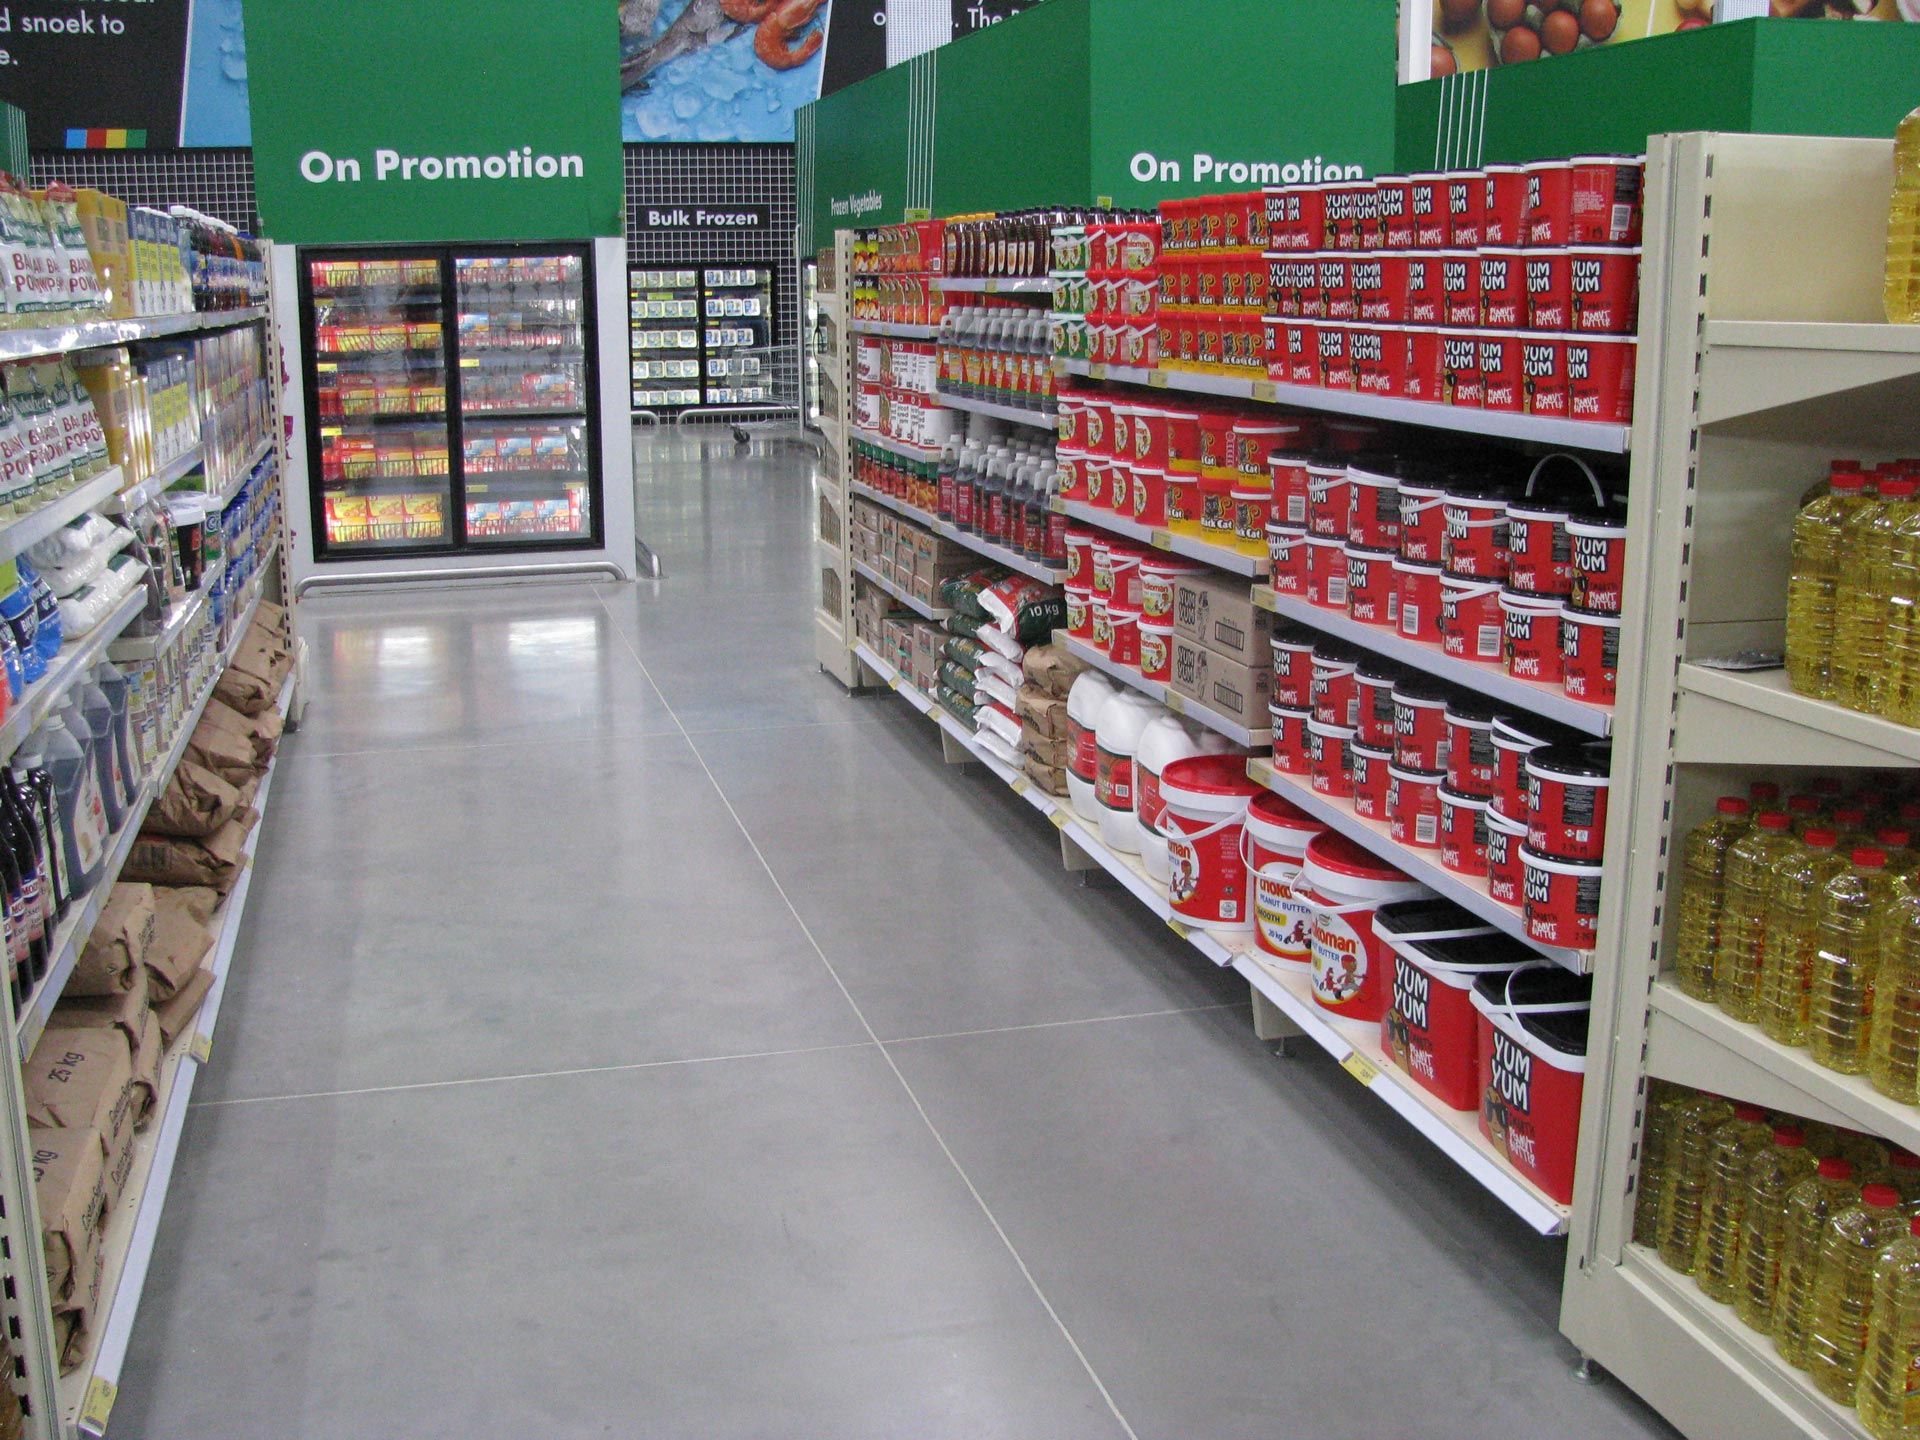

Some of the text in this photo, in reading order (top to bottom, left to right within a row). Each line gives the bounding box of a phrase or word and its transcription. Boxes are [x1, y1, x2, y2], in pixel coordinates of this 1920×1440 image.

[22, 9, 95, 34] snoek
[101, 14, 125, 35] to
[300, 147, 585, 184] On Promotion
[1130, 152, 1363, 183] On Promotion
[1378, 189, 1403, 202] YUM
[1413, 187, 1431, 200] UM
[1450, 185, 1466, 199] UM
[831, 190, 882, 218] Frozen Vegetables
[1326, 194, 1351, 207] YUM
[1352, 193, 1377, 206] YUM
[1450, 199, 1466, 213] UM
[1326, 207, 1352, 219] YUM
[1352, 206, 1377, 219] YUM
[1378, 202, 1402, 215] YUM
[1413, 201, 1431, 213] UM
[649, 210, 758, 226] Bulk Frozen
[1291, 264, 1315, 276] YUM
[1320, 264, 1343, 276] YUM
[1410, 263, 1424, 276] UM
[1481, 261, 1506, 275] YUM
[1572, 260, 1600, 276] YUM
[1291, 276, 1315, 288] YUM
[1320, 276, 1343, 288] YUM
[1410, 277, 1424, 290] UM
[1481, 276, 1505, 290] YUM
[1572, 276, 1599, 291] YUM
[1319, 332, 1341, 344] YUM
[1319, 344, 1341, 356] YUM
[1444, 340, 1474, 354] YUM
[1524, 345, 1553, 360] YUM
[1444, 354, 1473, 368] YUM
[1568, 347, 1587, 362] UM
[1524, 360, 1552, 376] YUM
[1568, 364, 1587, 378] UM
[1217, 520, 1232, 529] Cat
[1510, 522, 1527, 537] UM
[1247, 529, 1261, 539] Cat
[1510, 538, 1526, 552] UM
[1575, 537, 1607, 554] YUM
[1347, 560, 1367, 574] UM
[1575, 552, 1606, 571] YUM
[1348, 574, 1367, 588] UM
[1029, 604, 1060, 618] 10 kg
[1505, 620, 1531, 638] YUM
[1564, 623, 1578, 640] UM
[1259, 893, 1312, 915] PEANUT BUTTER
[1258, 909, 1280, 923] MOOTH
[1318, 946, 1340, 962] BUTTER
[1395, 958, 1428, 1002] YUM
[1394, 982, 1427, 1029] YUM
[1494, 1031, 1530, 1082] YUM
[48, 1051, 85, 1083] 25 kg
[1492, 1058, 1528, 1111] YUM
